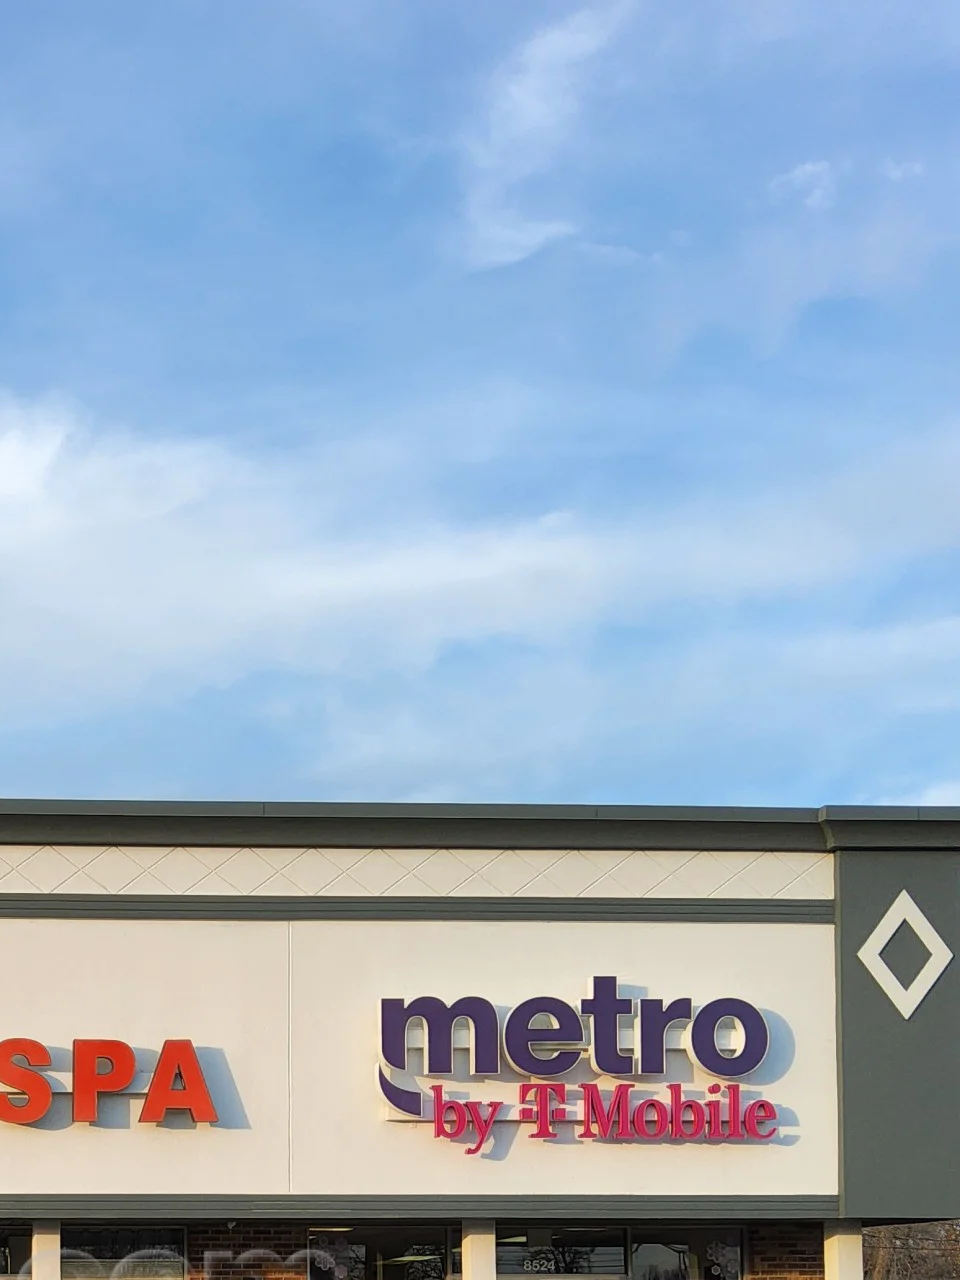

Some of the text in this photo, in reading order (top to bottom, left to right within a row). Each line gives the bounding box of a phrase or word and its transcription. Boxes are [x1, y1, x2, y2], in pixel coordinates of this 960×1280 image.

[378, 976, 770, 1117] metro
[429, 1084, 504, 1155] by
[523, 1259, 556, 1271] 8524
